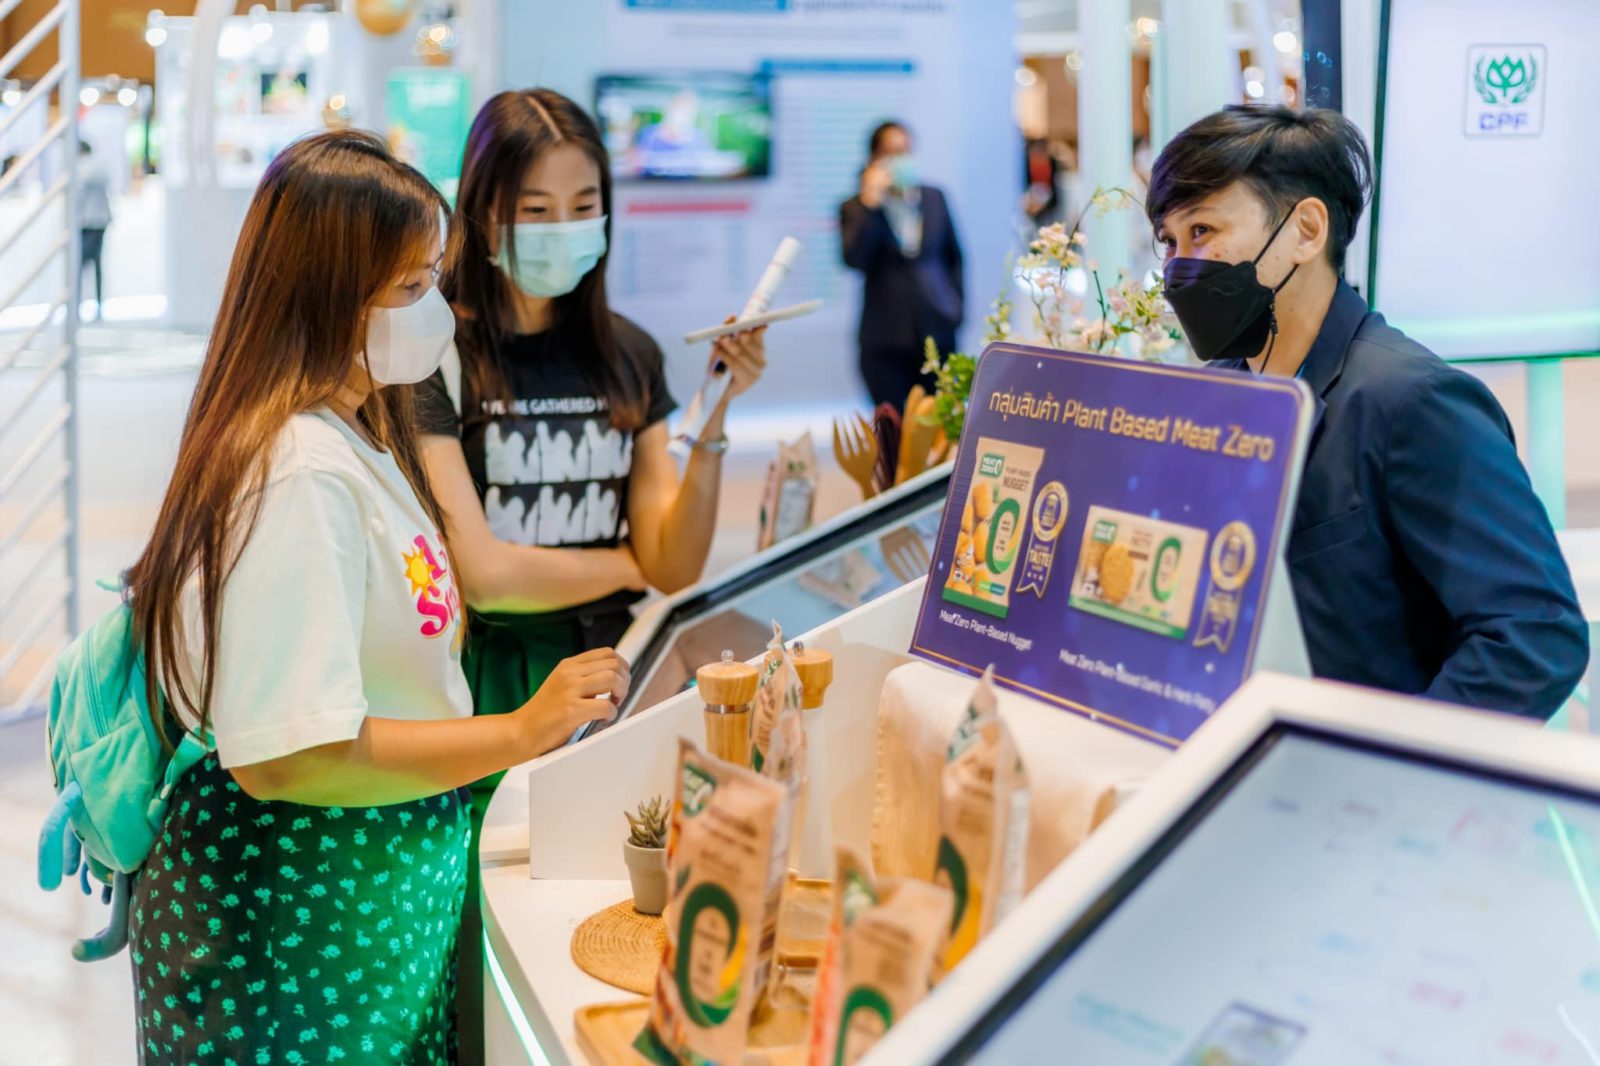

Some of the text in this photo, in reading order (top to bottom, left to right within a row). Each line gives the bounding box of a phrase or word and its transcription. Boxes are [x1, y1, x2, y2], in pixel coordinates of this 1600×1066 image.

[1480, 112, 1528, 130] CPF
[989, 386, 1275, 461] กลุ่มสินค้า Plant Based Meat Zero
[940, 609, 1032, 651] Meat Zero Plant-Based Nugget
